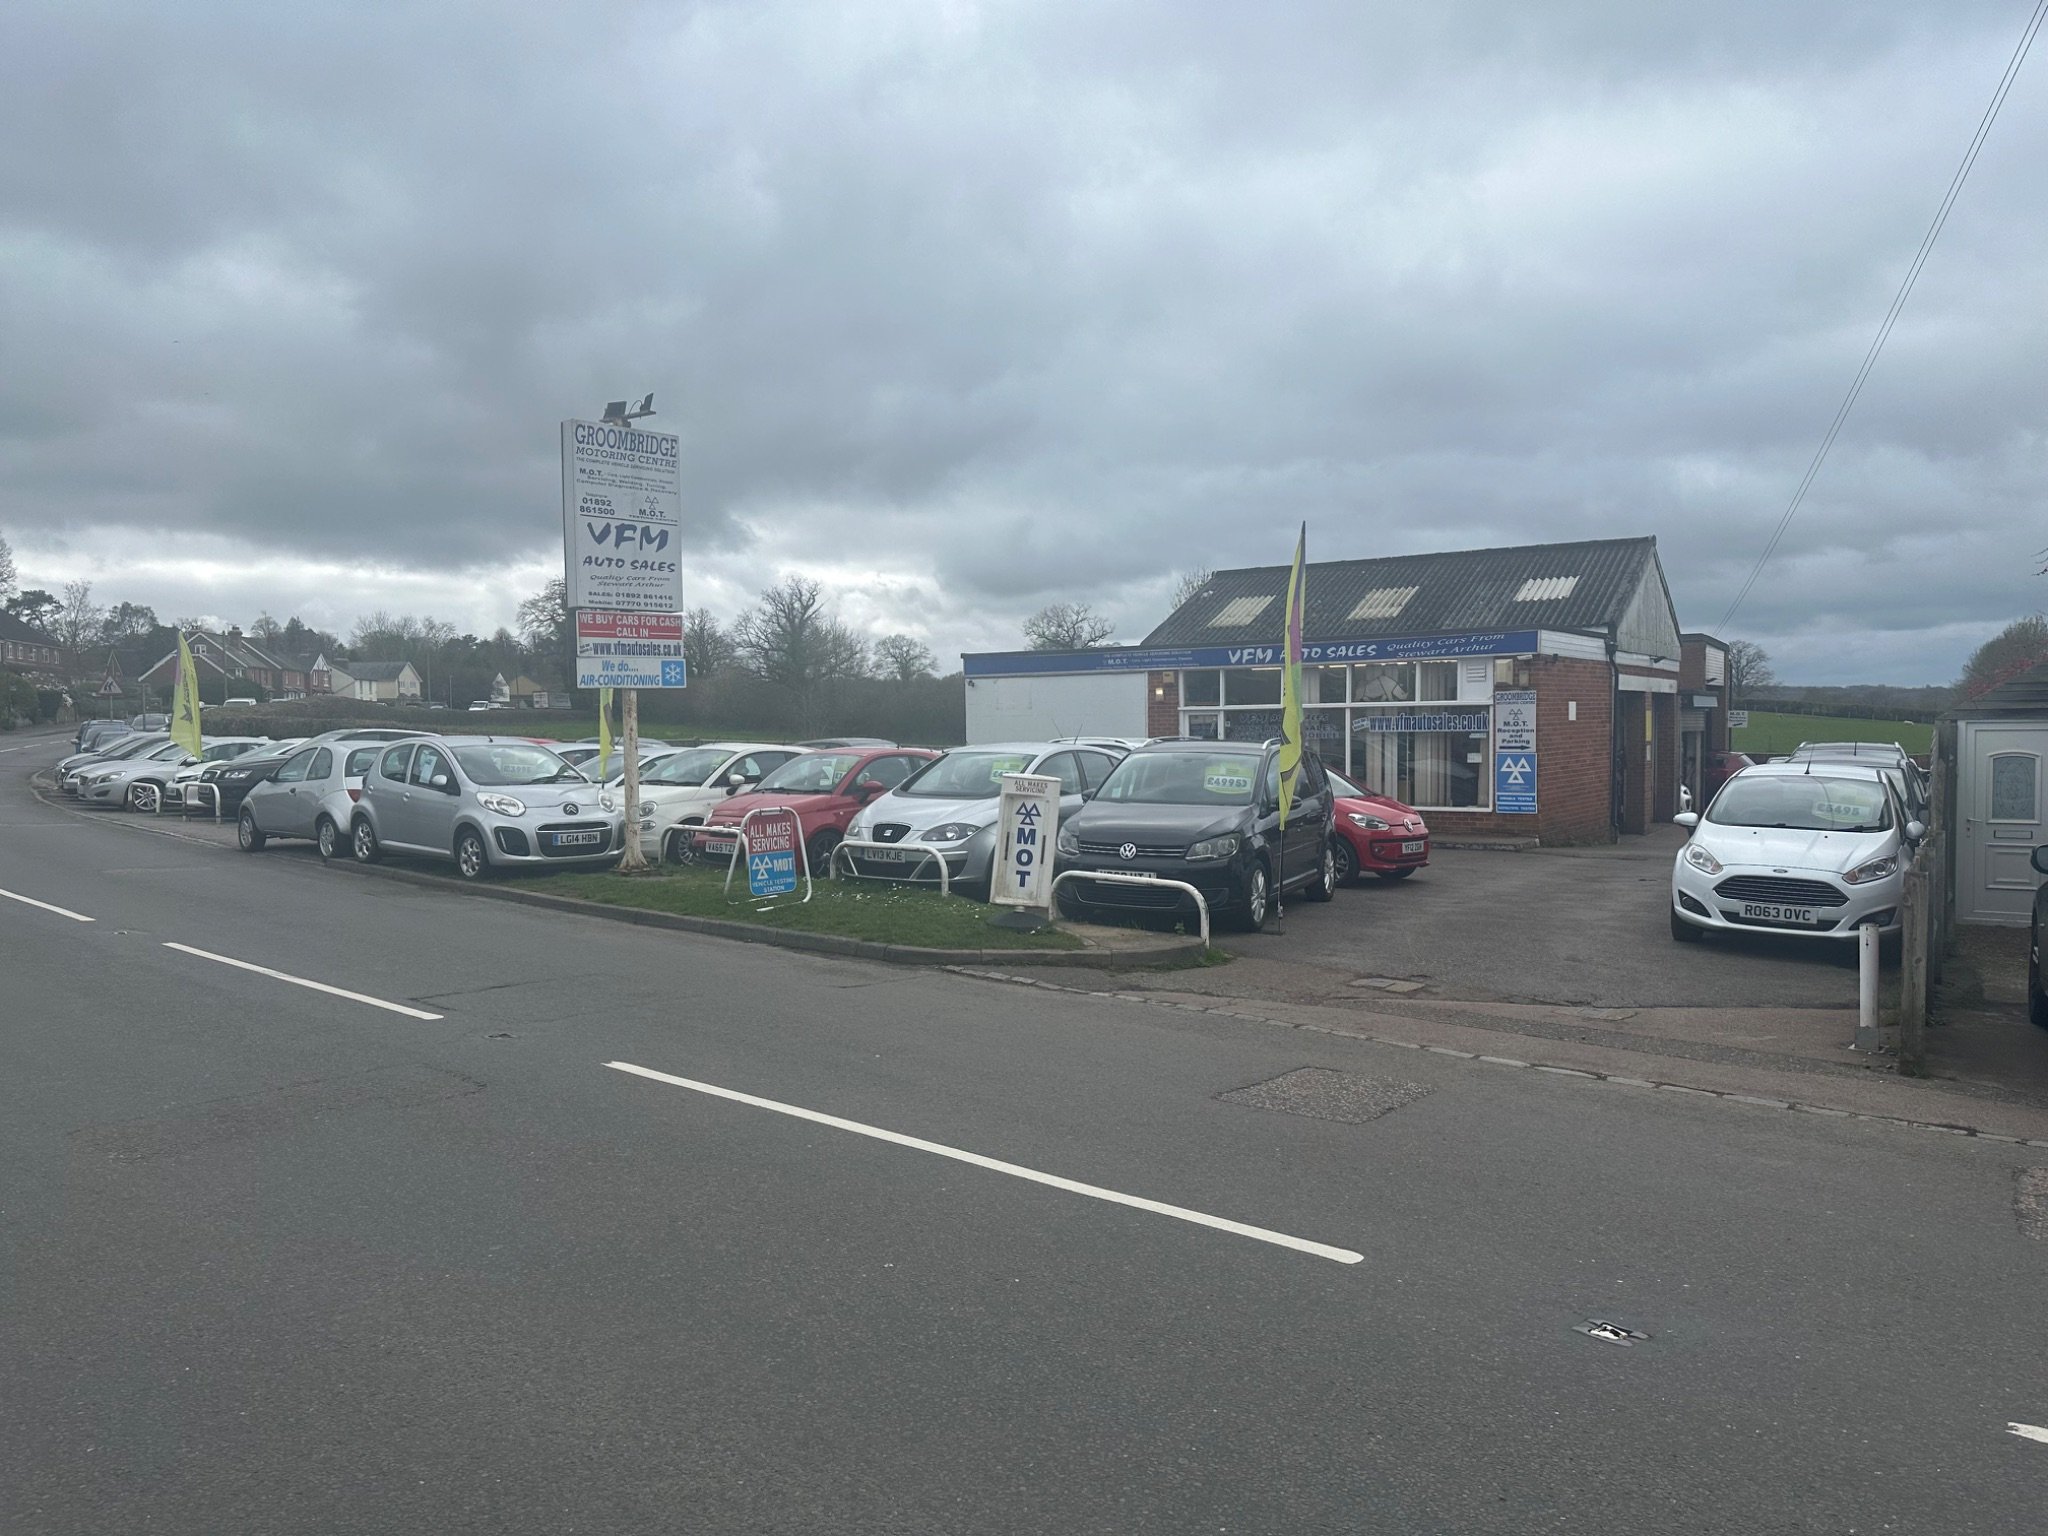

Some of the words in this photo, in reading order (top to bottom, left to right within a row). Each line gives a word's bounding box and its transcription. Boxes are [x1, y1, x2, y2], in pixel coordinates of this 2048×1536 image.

[575, 424, 678, 458] GROOMBRIDGE
[576, 446, 636, 462] MOTORING
[638, 455, 677, 468] CENTRE
[582, 497, 612, 507] 01892
[579, 505, 615, 516] 861500
[639, 508, 667, 519] M.O.T.
[587, 522, 669, 553] VFM
[583, 555, 626, 569] AUTO
[629, 560, 676, 573] SALES
[590, 574, 624, 582] Quality
[580, 614, 593, 624] WE
[595, 614, 614, 625] BUY
[616, 615, 639, 626] CARS
[641, 617, 657, 627] FOR
[659, 617, 681, 627] CASH
[616, 627, 638, 637] CALL
[640, 629, 649, 638] IN
[592, 641, 682, 656] www.vfmautosales.co.uk
[1387, 640, 1434, 652] Quality
[1437, 637, 1467, 646] Cars
[1470, 634, 1505, 643] From
[1228, 648, 1273, 664] VFM
[1280, 647, 1322, 661] ATO
[1327, 645, 1378, 659] SALES
[1397, 648, 1447, 658] Stewart
[1450, 643, 1496, 653] Arthur
[602, 659, 615, 672] We
[579, 673, 660, 687] AIR-CONDITIONING
[1369, 713, 1489, 732] www.vfmautosales.co.uk
[1014, 779, 1026, 787] ALL
[1015, 786, 1046, 794] SERVICING
[750, 823, 764, 838] ALL
[766, 822, 791, 837] MAKES
[560, 834, 579, 844] LG14
[752, 836, 790, 852] SERVICING
[867, 850, 885, 860] LV13
[886, 850, 903, 861] KJE
[1016, 827, 1036, 887] MOT
[773, 857, 793, 872] MOT
[752, 880, 774, 888] VEHICLE
[774, 877, 795, 885] TESTING
[763, 885, 785, 893] STATION
[1744, 904, 1781, 918] RO63
